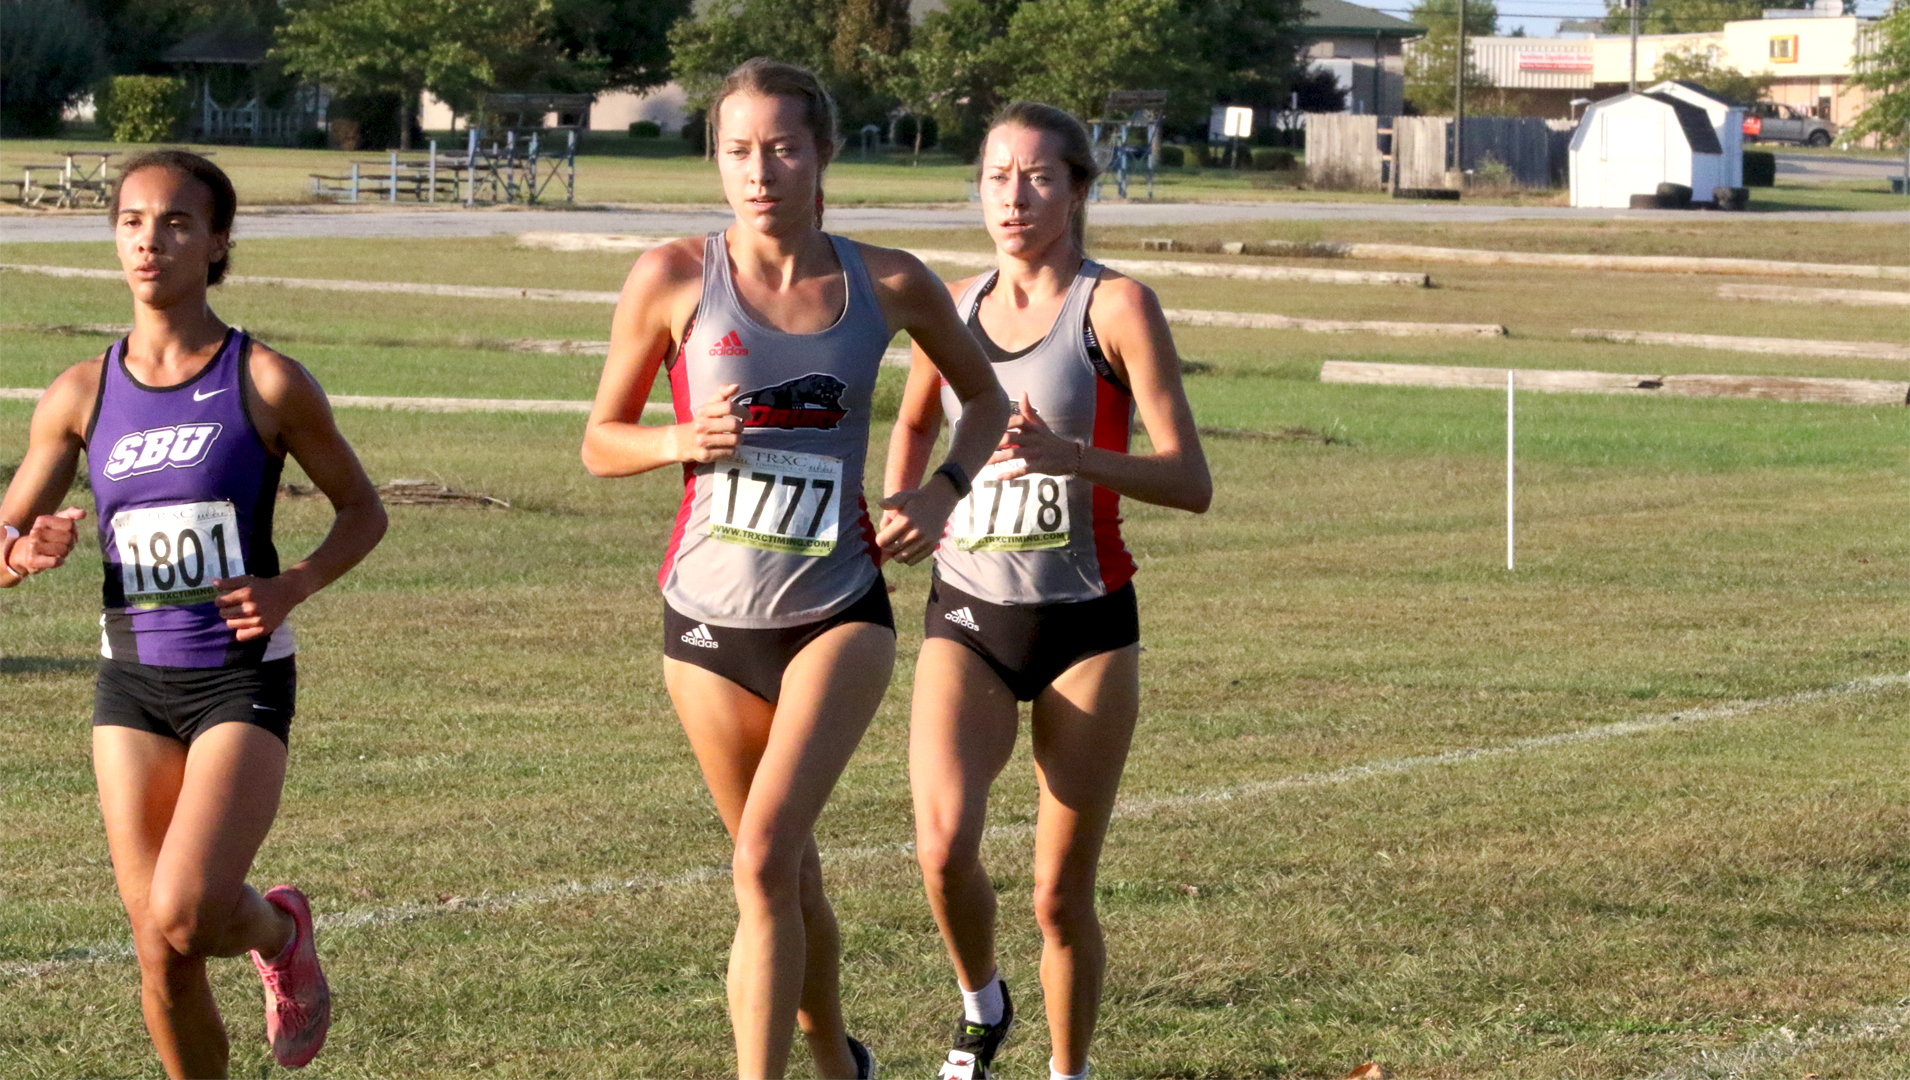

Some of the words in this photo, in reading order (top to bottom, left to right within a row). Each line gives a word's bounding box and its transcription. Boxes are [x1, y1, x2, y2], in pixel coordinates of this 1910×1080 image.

[709, 346, 749, 356] adidas
[103, 423, 223, 481] SBU
[753, 450, 808, 468] TRXC
[725, 468, 835, 538] 1777
[968, 477, 1062, 535] 1778
[712, 523, 830, 548] WWW.TRXCTIMING.COM
[957, 532, 1065, 545] W.TRXCTIMING.COM
[127, 523, 230, 592] 1801
[127, 585, 219, 602] WWW.TRXCTIMING.
[944, 611, 980, 632] adidas
[680, 633, 719, 649] adidas
